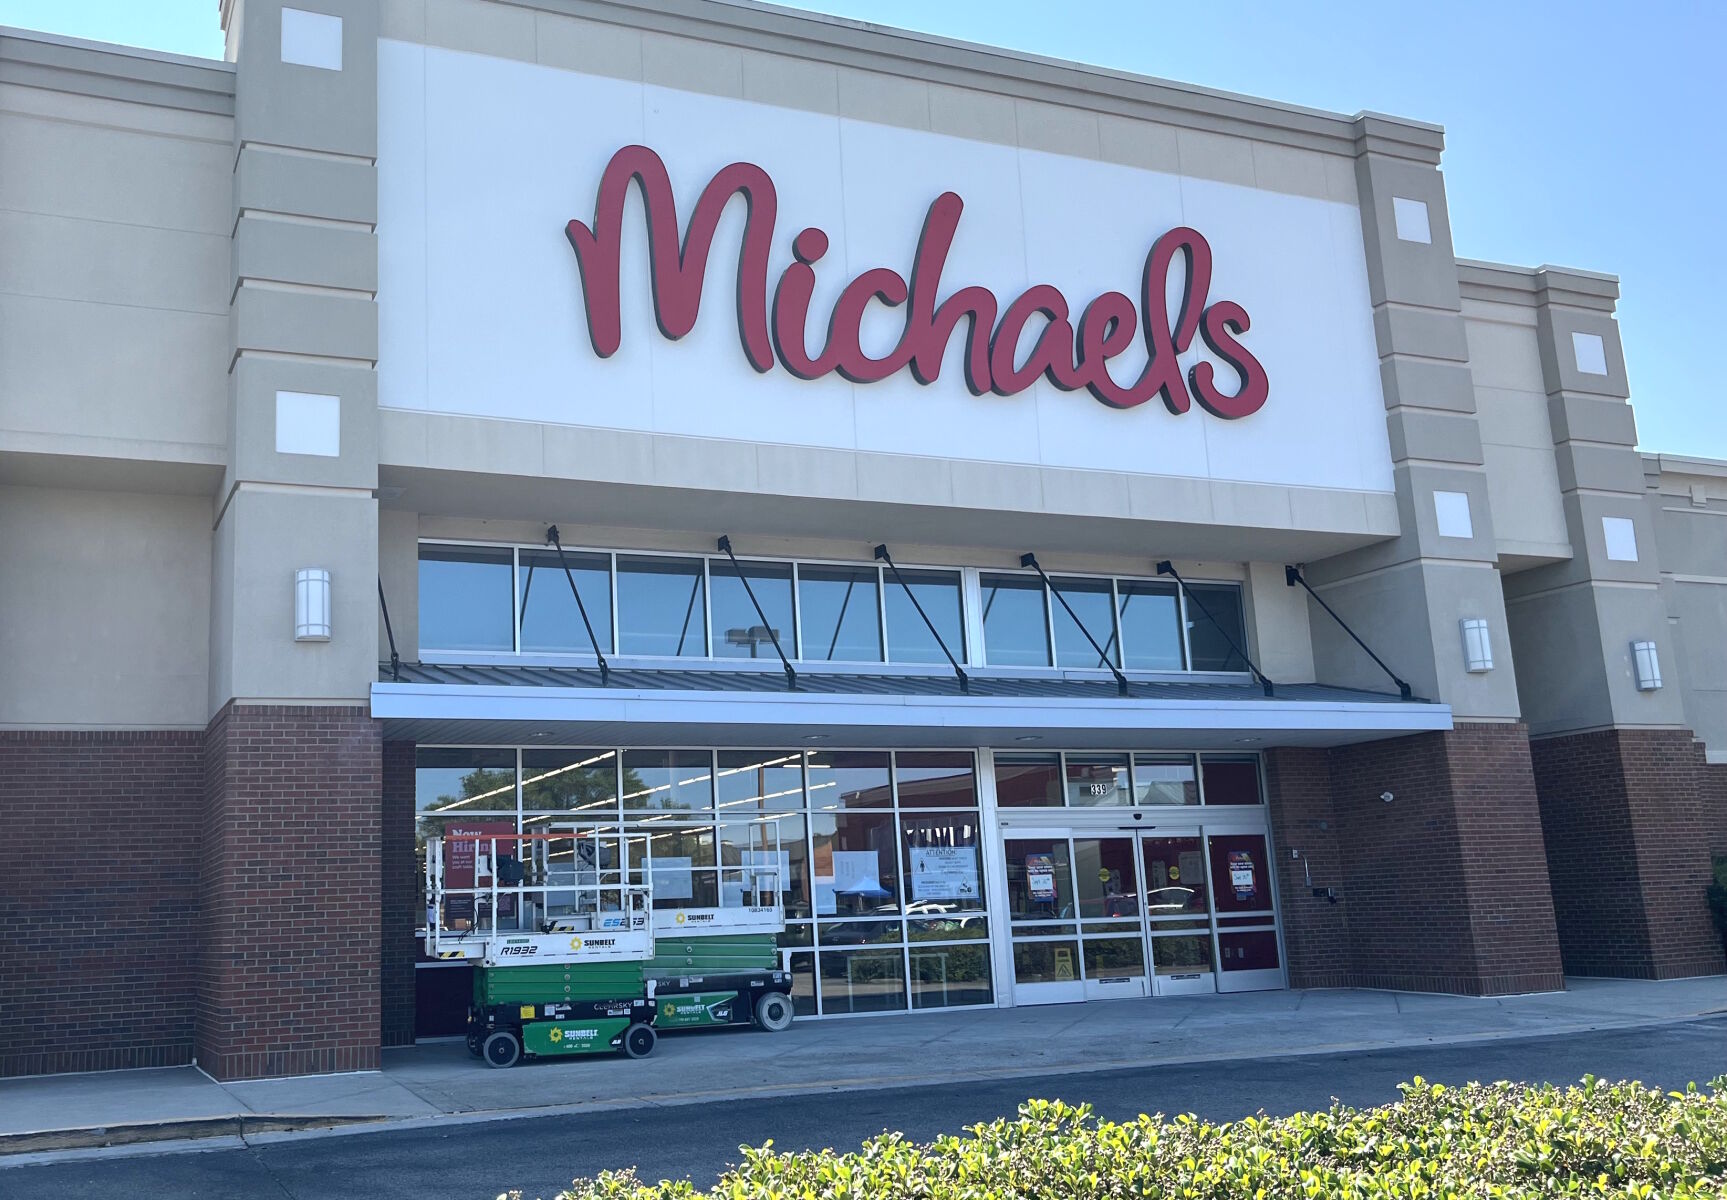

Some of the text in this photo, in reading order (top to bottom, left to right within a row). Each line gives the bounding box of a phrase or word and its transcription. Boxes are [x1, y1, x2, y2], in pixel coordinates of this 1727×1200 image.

[565, 144, 1269, 420] Michaels
[1091, 784, 1107, 795] 339
[501, 945, 538, 955] R1932
[564, 1029, 599, 1038] SUNBELT
